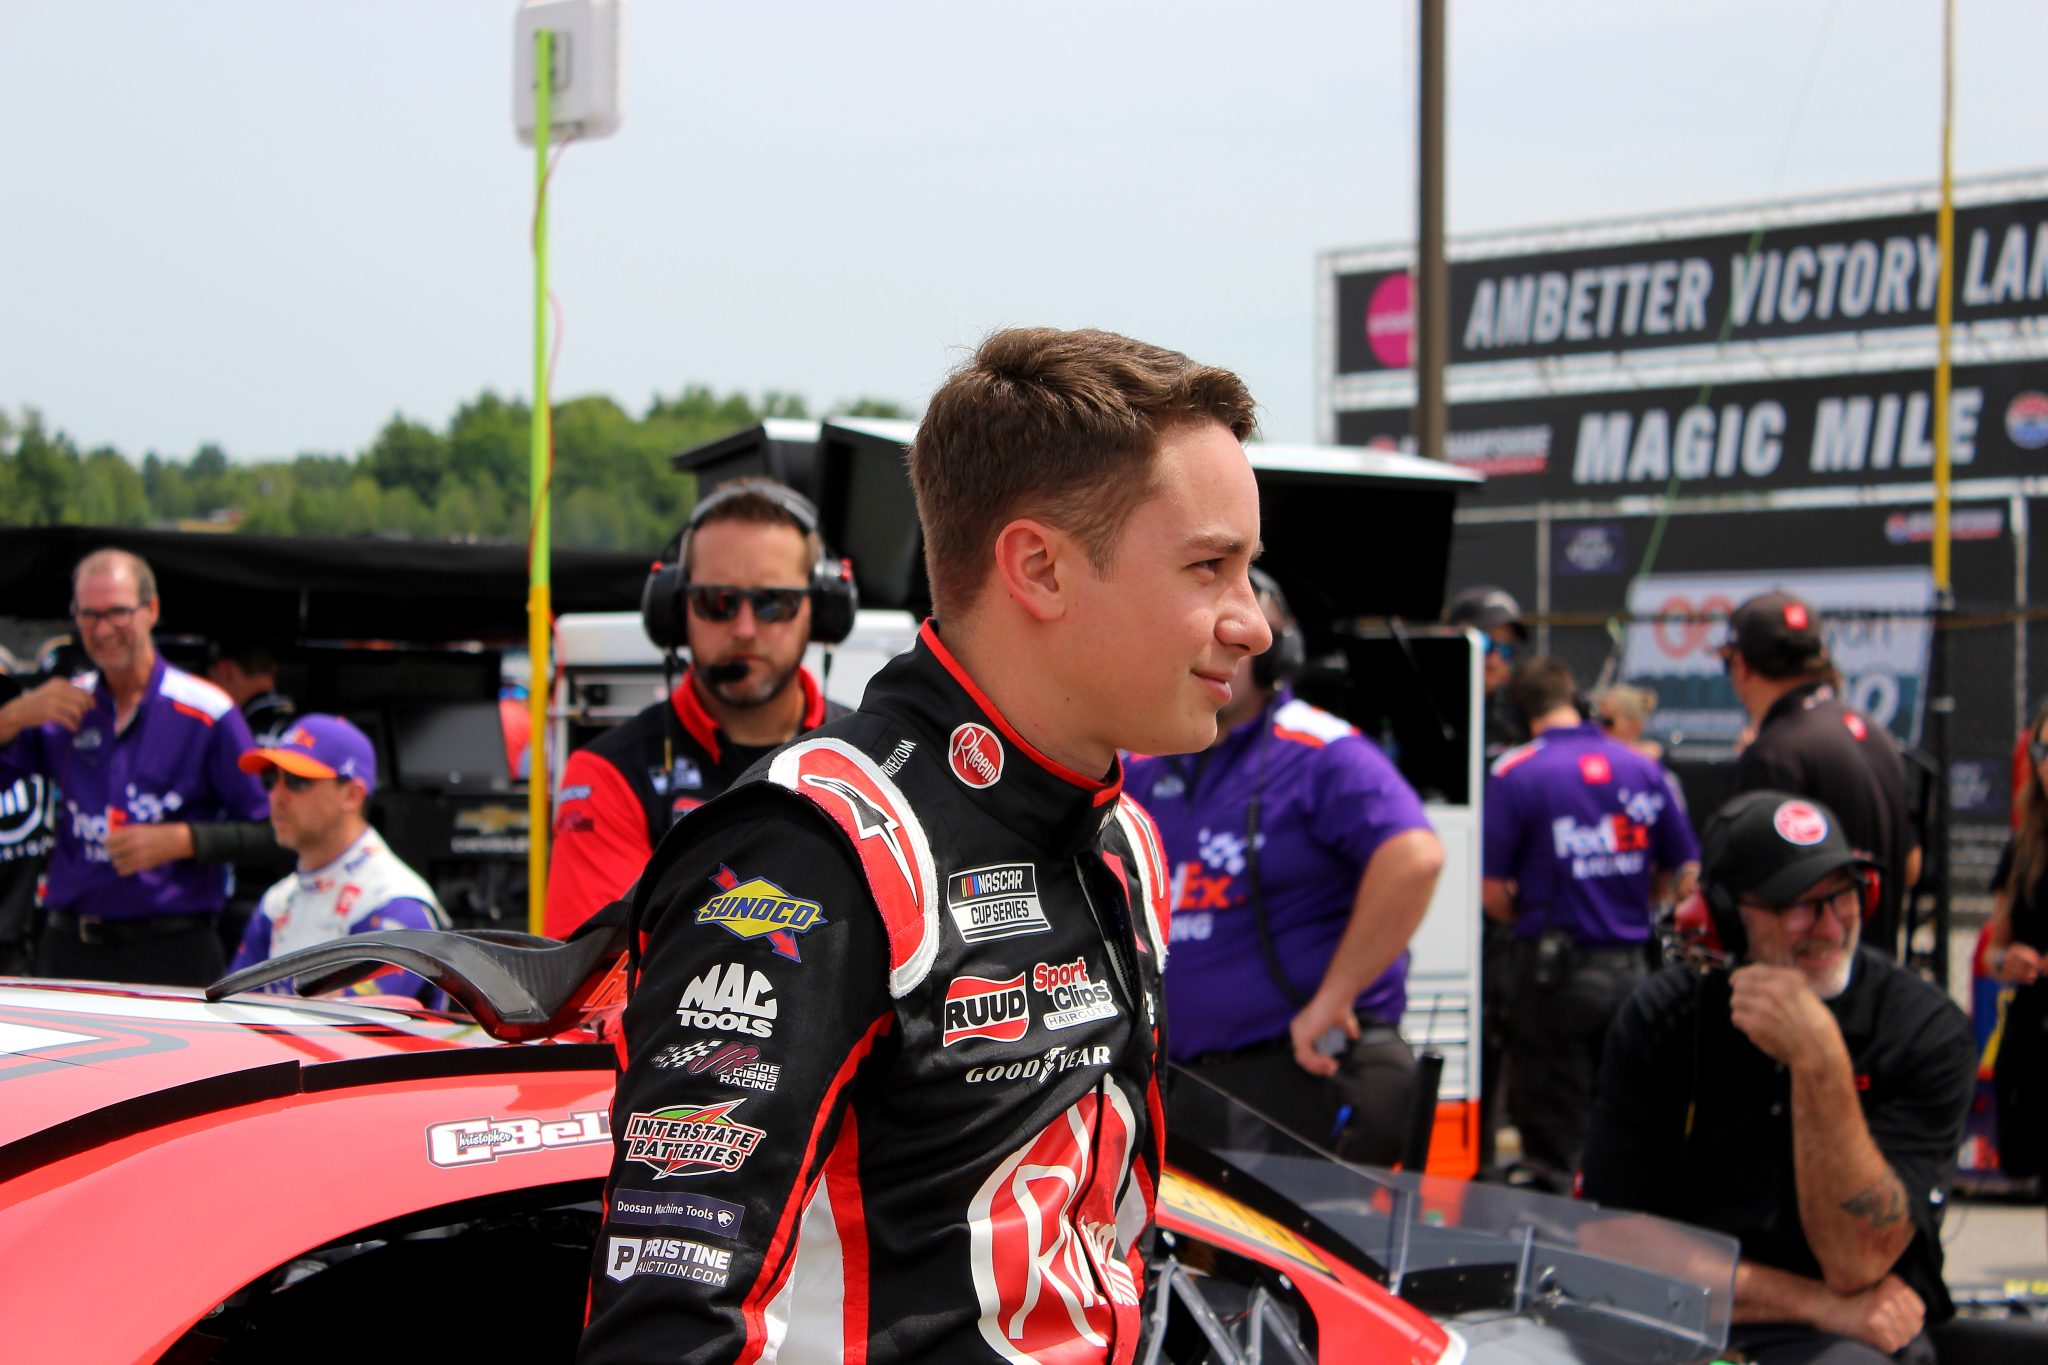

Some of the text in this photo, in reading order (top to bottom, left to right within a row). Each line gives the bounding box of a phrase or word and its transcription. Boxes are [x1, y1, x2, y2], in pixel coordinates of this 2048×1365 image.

[1463, 257, 1713, 349] AMBETTER
[1730, 234, 1941, 327] VICTORY
[1573, 387, 1983, 484] MAGIC MILE
[952, 727, 998, 782] Rheem
[978, 870, 1023, 894] NASCAR
[700, 896, 815, 926] SUNOCO
[971, 900, 1029, 925] CUP SERIES
[1034, 959, 1087, 992] Sport
[679, 962, 777, 1020] MAC
[1053, 983, 1110, 1011] Clips
[677, 1009, 773, 1038] TOOLS
[945, 989, 1027, 1032] RUUD
[1048, 1005, 1113, 1026] HAIRCUTS
[732, 1067, 778, 1083] GIBBS
[747, 1062, 781, 1073] JOE
[719, 1074, 776, 1092] RACING
[632, 1118, 756, 1149] INTERSTATE
[633, 1138, 741, 1166] BATTERIES
[617, 1200, 653, 1215] Doosan
[686, 1205, 714, 1220] Tools
[642, 1239, 732, 1271] PRISTINE
[636, 1261, 728, 1285] AUCTION.COM
